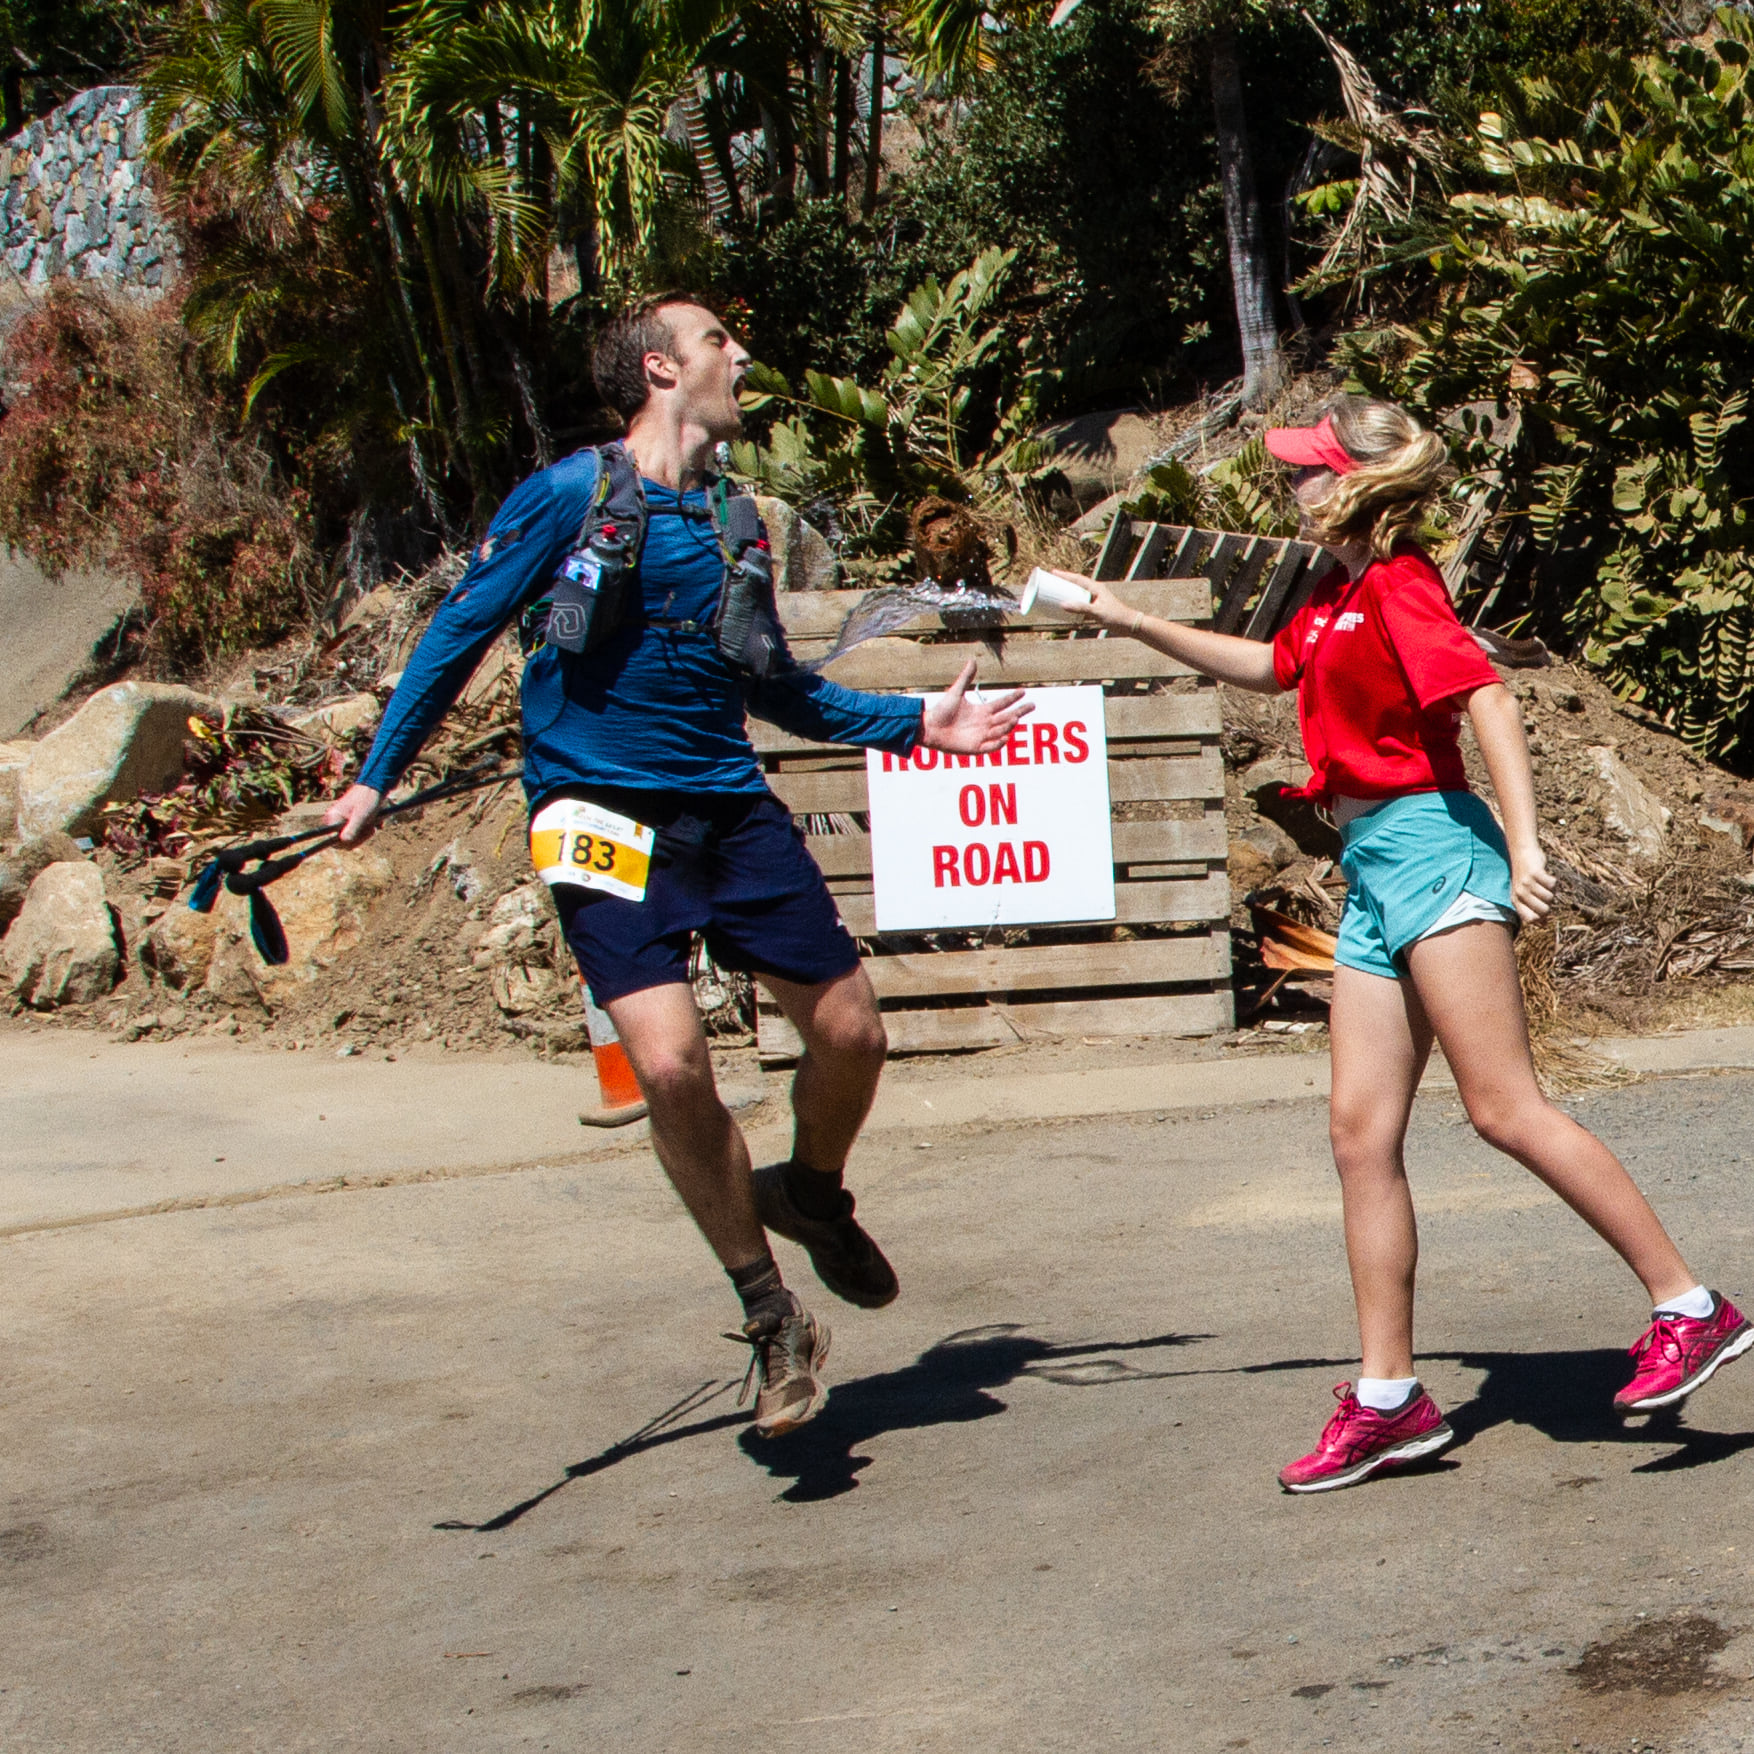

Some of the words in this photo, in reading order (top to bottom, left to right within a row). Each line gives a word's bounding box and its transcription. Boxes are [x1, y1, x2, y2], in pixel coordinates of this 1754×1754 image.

[959, 783, 1018, 827] ON
[558, 832, 616, 871] 183
[932, 840, 1050, 888] ROAD
